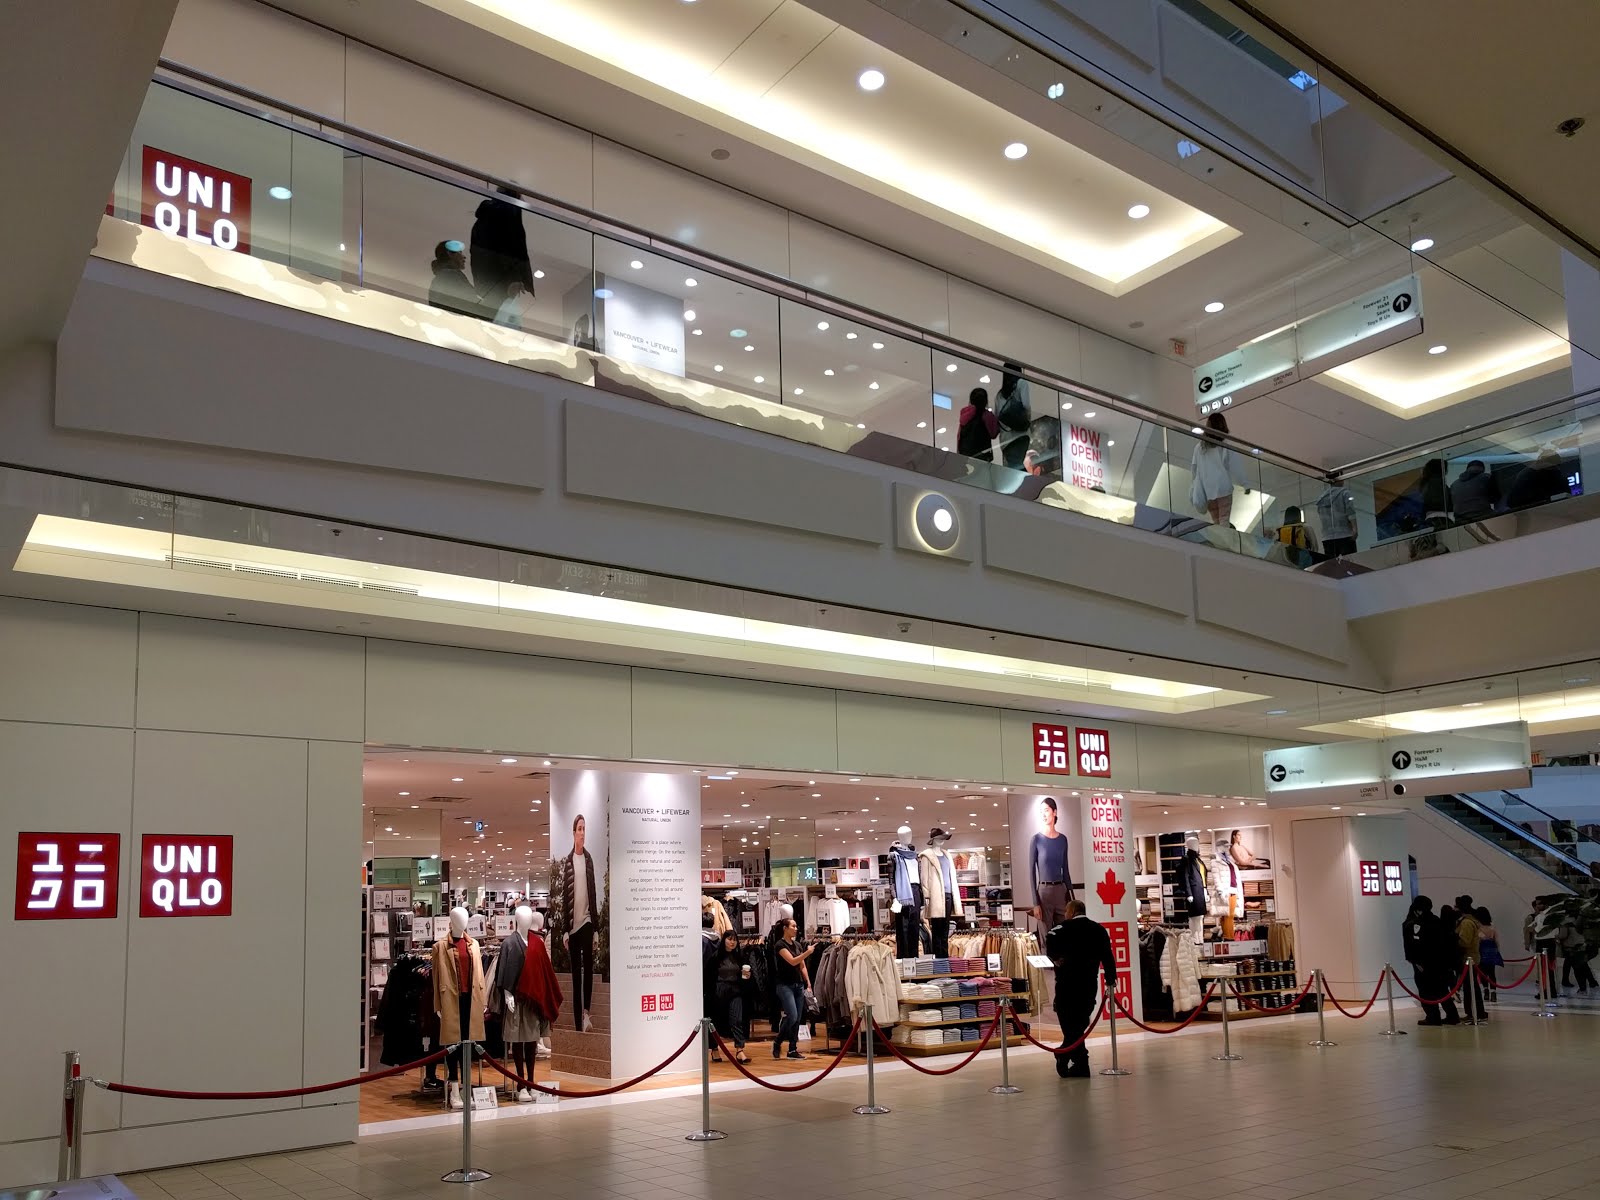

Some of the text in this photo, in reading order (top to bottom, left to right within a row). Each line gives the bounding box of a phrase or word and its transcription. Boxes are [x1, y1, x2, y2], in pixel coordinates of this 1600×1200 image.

[156, 160, 231, 213] UNI
[1362, 299, 1382, 309] Forever
[613, 330, 644, 344] VANCOUVER
[651, 341, 678, 354] LIFEWEAR
[1228, 363, 1242, 372] Towers
[1273, 372, 1293, 382] GROUND
[1070, 424, 1101, 448] NOW
[1071, 443, 1102, 464] OPEN!
[1072, 460, 1103, 479] UNIQLO
[1038, 729, 1065, 748] ユニ
[1080, 732, 1105, 752] UNI
[1038, 750, 1066, 768] クロ
[1081, 752, 1108, 773] QLO
[1091, 807, 1122, 822] OPEN!
[1092, 826, 1124, 840] UNIQLO
[1093, 841, 1124, 853] MEETS
[32, 844, 106, 872] ユニ
[153, 845, 216, 873] UNI
[1385, 866, 1400, 878] UNI
[27, 880, 104, 908] クロ
[152, 878, 222, 911] QLO
[1386, 880, 1402, 894] QLO
